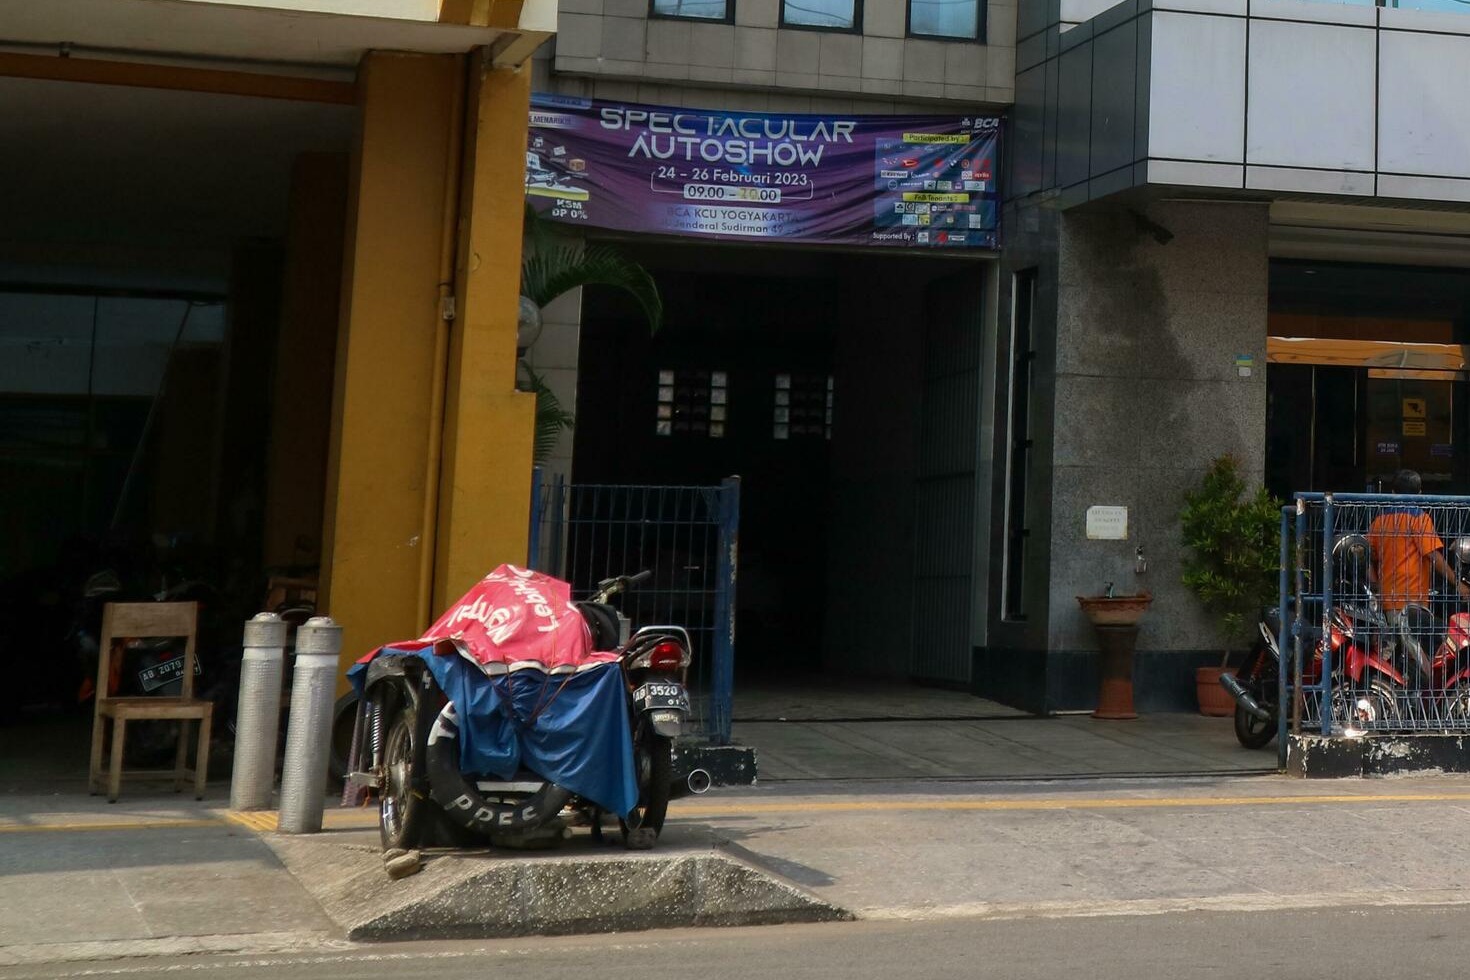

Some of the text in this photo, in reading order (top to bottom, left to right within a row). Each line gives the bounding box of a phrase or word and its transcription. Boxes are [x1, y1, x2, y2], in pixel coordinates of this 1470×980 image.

[600, 106, 857, 143] SPECTACULAR
[973, 118, 999, 129] BCA
[627, 134, 825, 167] AUTOSHOW
[658, 166, 676, 179] 24
[692, 168, 709, 180] 26
[713, 169, 770, 184] Februari
[774, 172, 808, 186] 2023
[688, 185, 725, 199] 09.00
[667, 207, 800, 222] BCA KCU YOGYAKARTA
[722, 222, 768, 233] Sudirman
[873, 232, 903, 242] Supported
[650, 685, 678, 696] 3520
